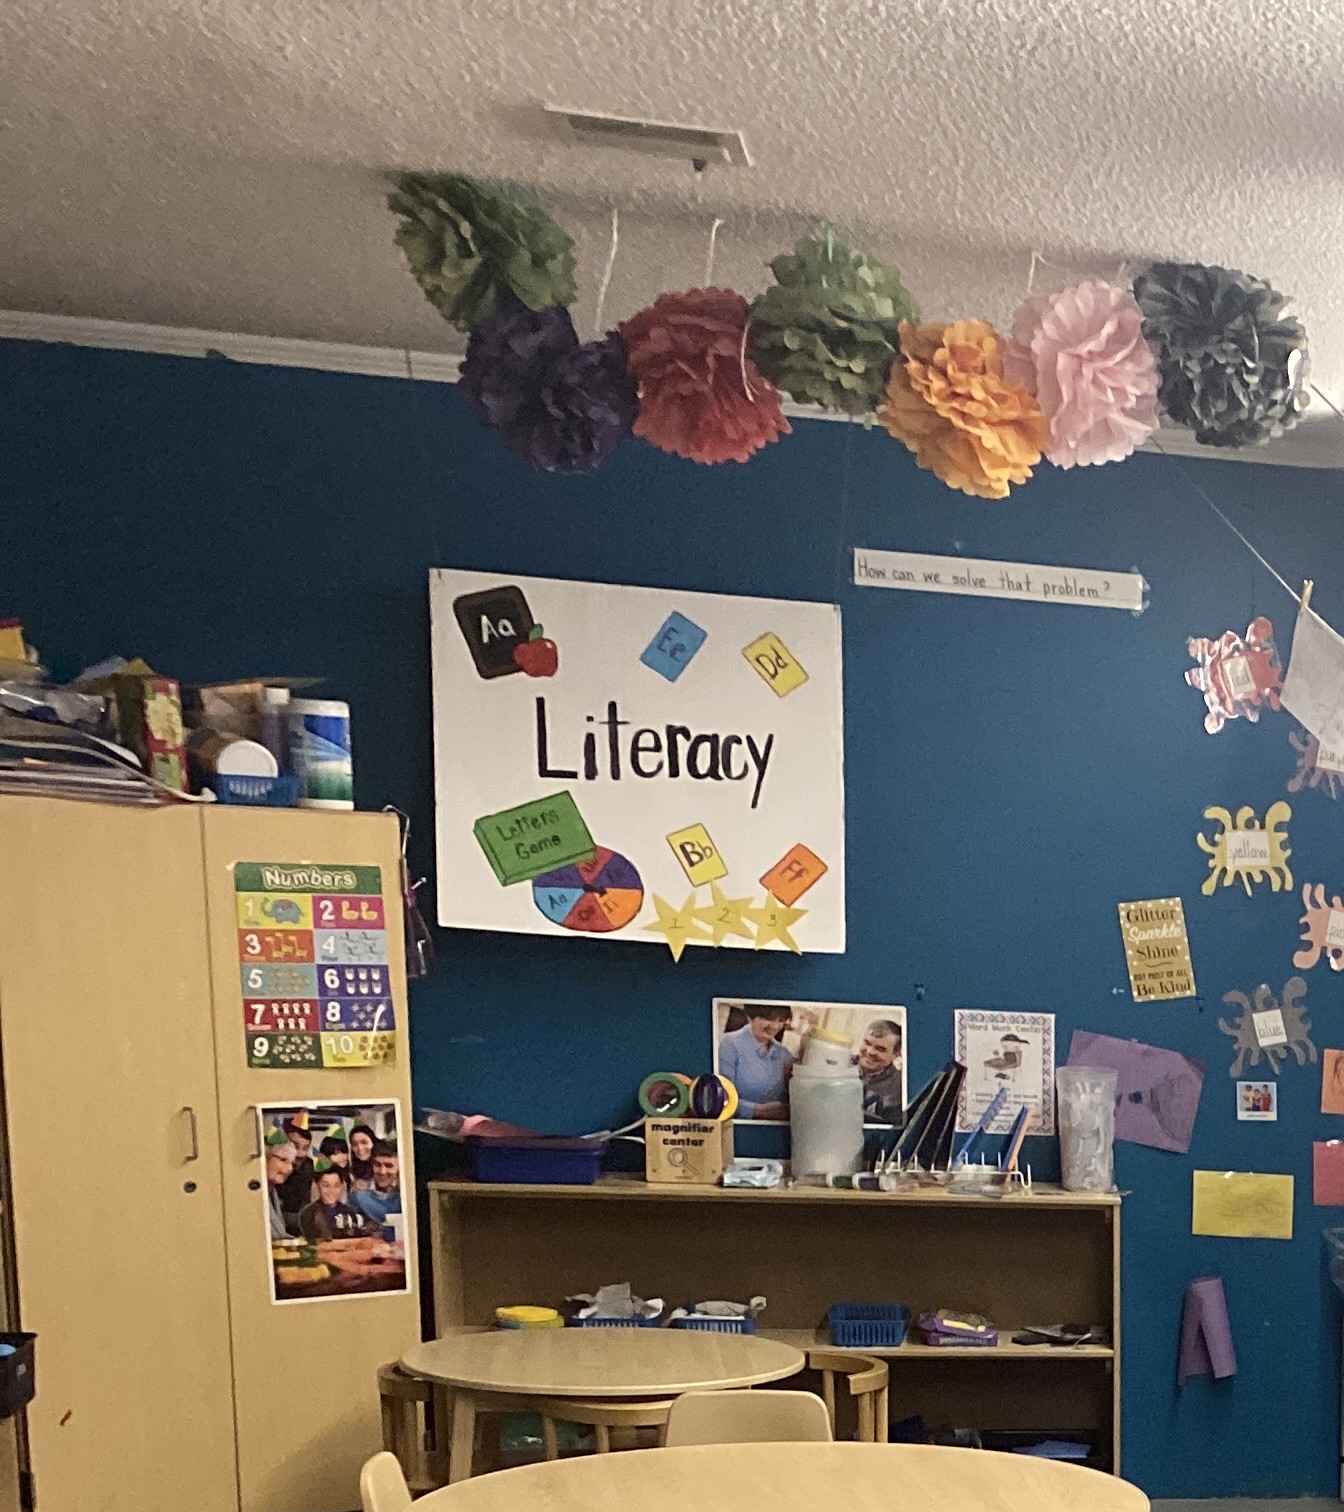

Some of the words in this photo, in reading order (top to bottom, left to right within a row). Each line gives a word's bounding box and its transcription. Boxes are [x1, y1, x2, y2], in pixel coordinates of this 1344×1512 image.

[857, 558, 887, 579] How
[892, 568, 915, 582] can
[923, 571, 941, 583] we
[952, 569, 986, 588] solve
[999, 571, 1032, 592] that
[480, 615, 517, 643] Aa
[657, 625, 686, 660] Ee
[755, 645, 789, 679] Dd
[535, 697, 775, 809] Literacy
[496, 808, 560, 841] Letters
[514, 834, 562, 860] Game
[679, 840, 713, 868] Bb
[1231, 838, 1268, 865] yellow
[264, 868, 355, 889] Numbers
[245, 899, 254, 917] 1
[319, 900, 336, 921] 2
[1126, 908, 1177, 924] Glitter
[244, 933, 261, 955] 3
[1128, 922, 1182, 945] Sparkle
[321, 935, 336, 955] 4
[1136, 945, 1179, 960] Shine
[247, 968, 263, 989] 5
[324, 968, 340, 990] 6
[1136, 983, 1156, 997] Be
[1160, 978, 1192, 994] Kind
[249, 1004, 266, 1025] 7
[325, 1001, 341, 1022] 8
[1258, 1019, 1284, 1039] blue
[253, 1036, 269, 1058] 9
[325, 1034, 354, 1056] 10
[651, 1121, 715, 1135] magnifier
[662, 1137, 705, 1147] center
